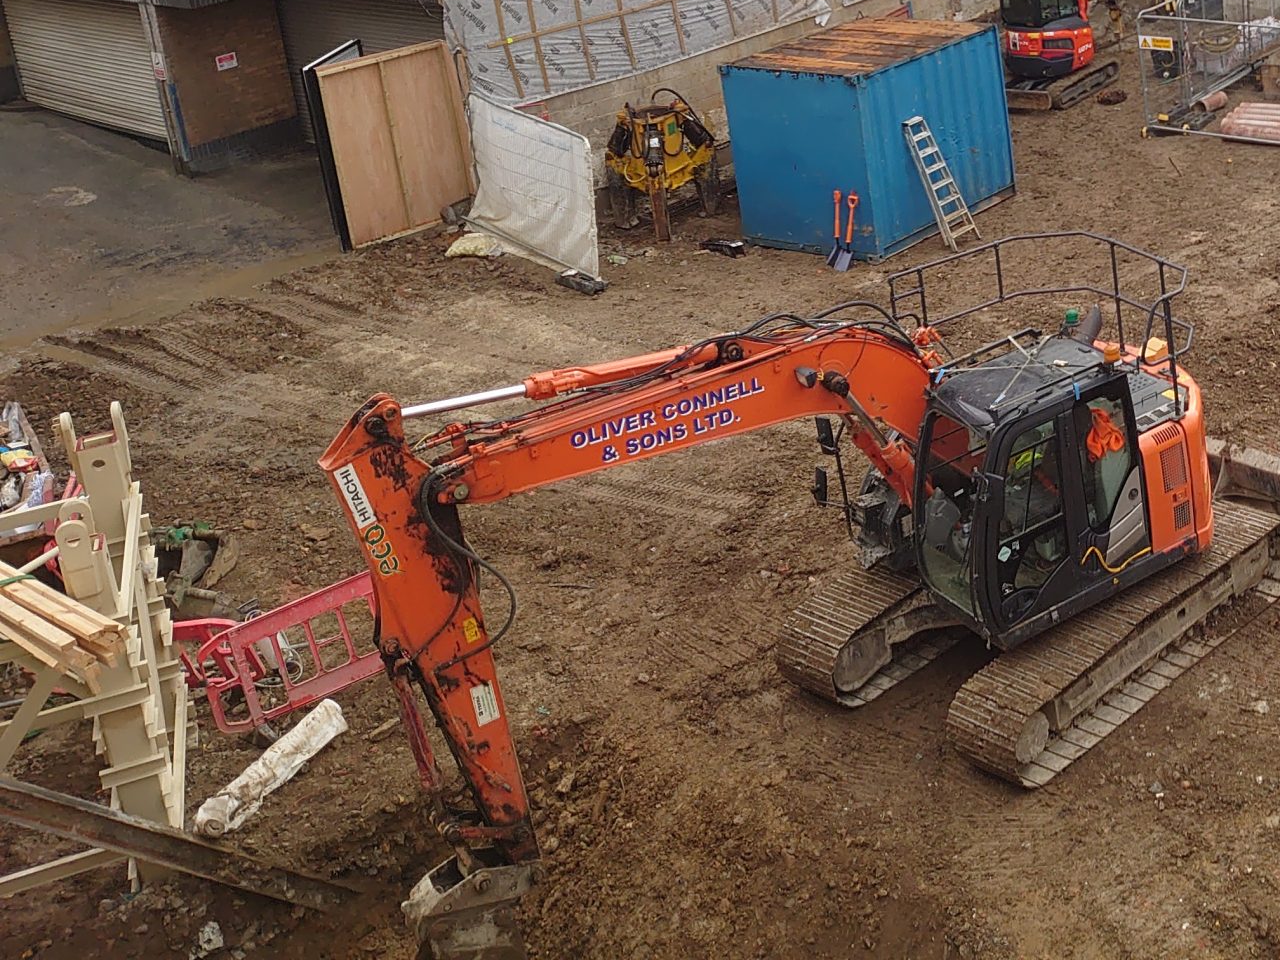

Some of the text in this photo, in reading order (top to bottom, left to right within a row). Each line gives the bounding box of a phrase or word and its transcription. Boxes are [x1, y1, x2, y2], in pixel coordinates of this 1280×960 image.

[570, 377, 765, 449] OLIVER CONNELL
[601, 408, 741, 462] & SONS LTD.
[339, 468, 372, 523] HITACHI
